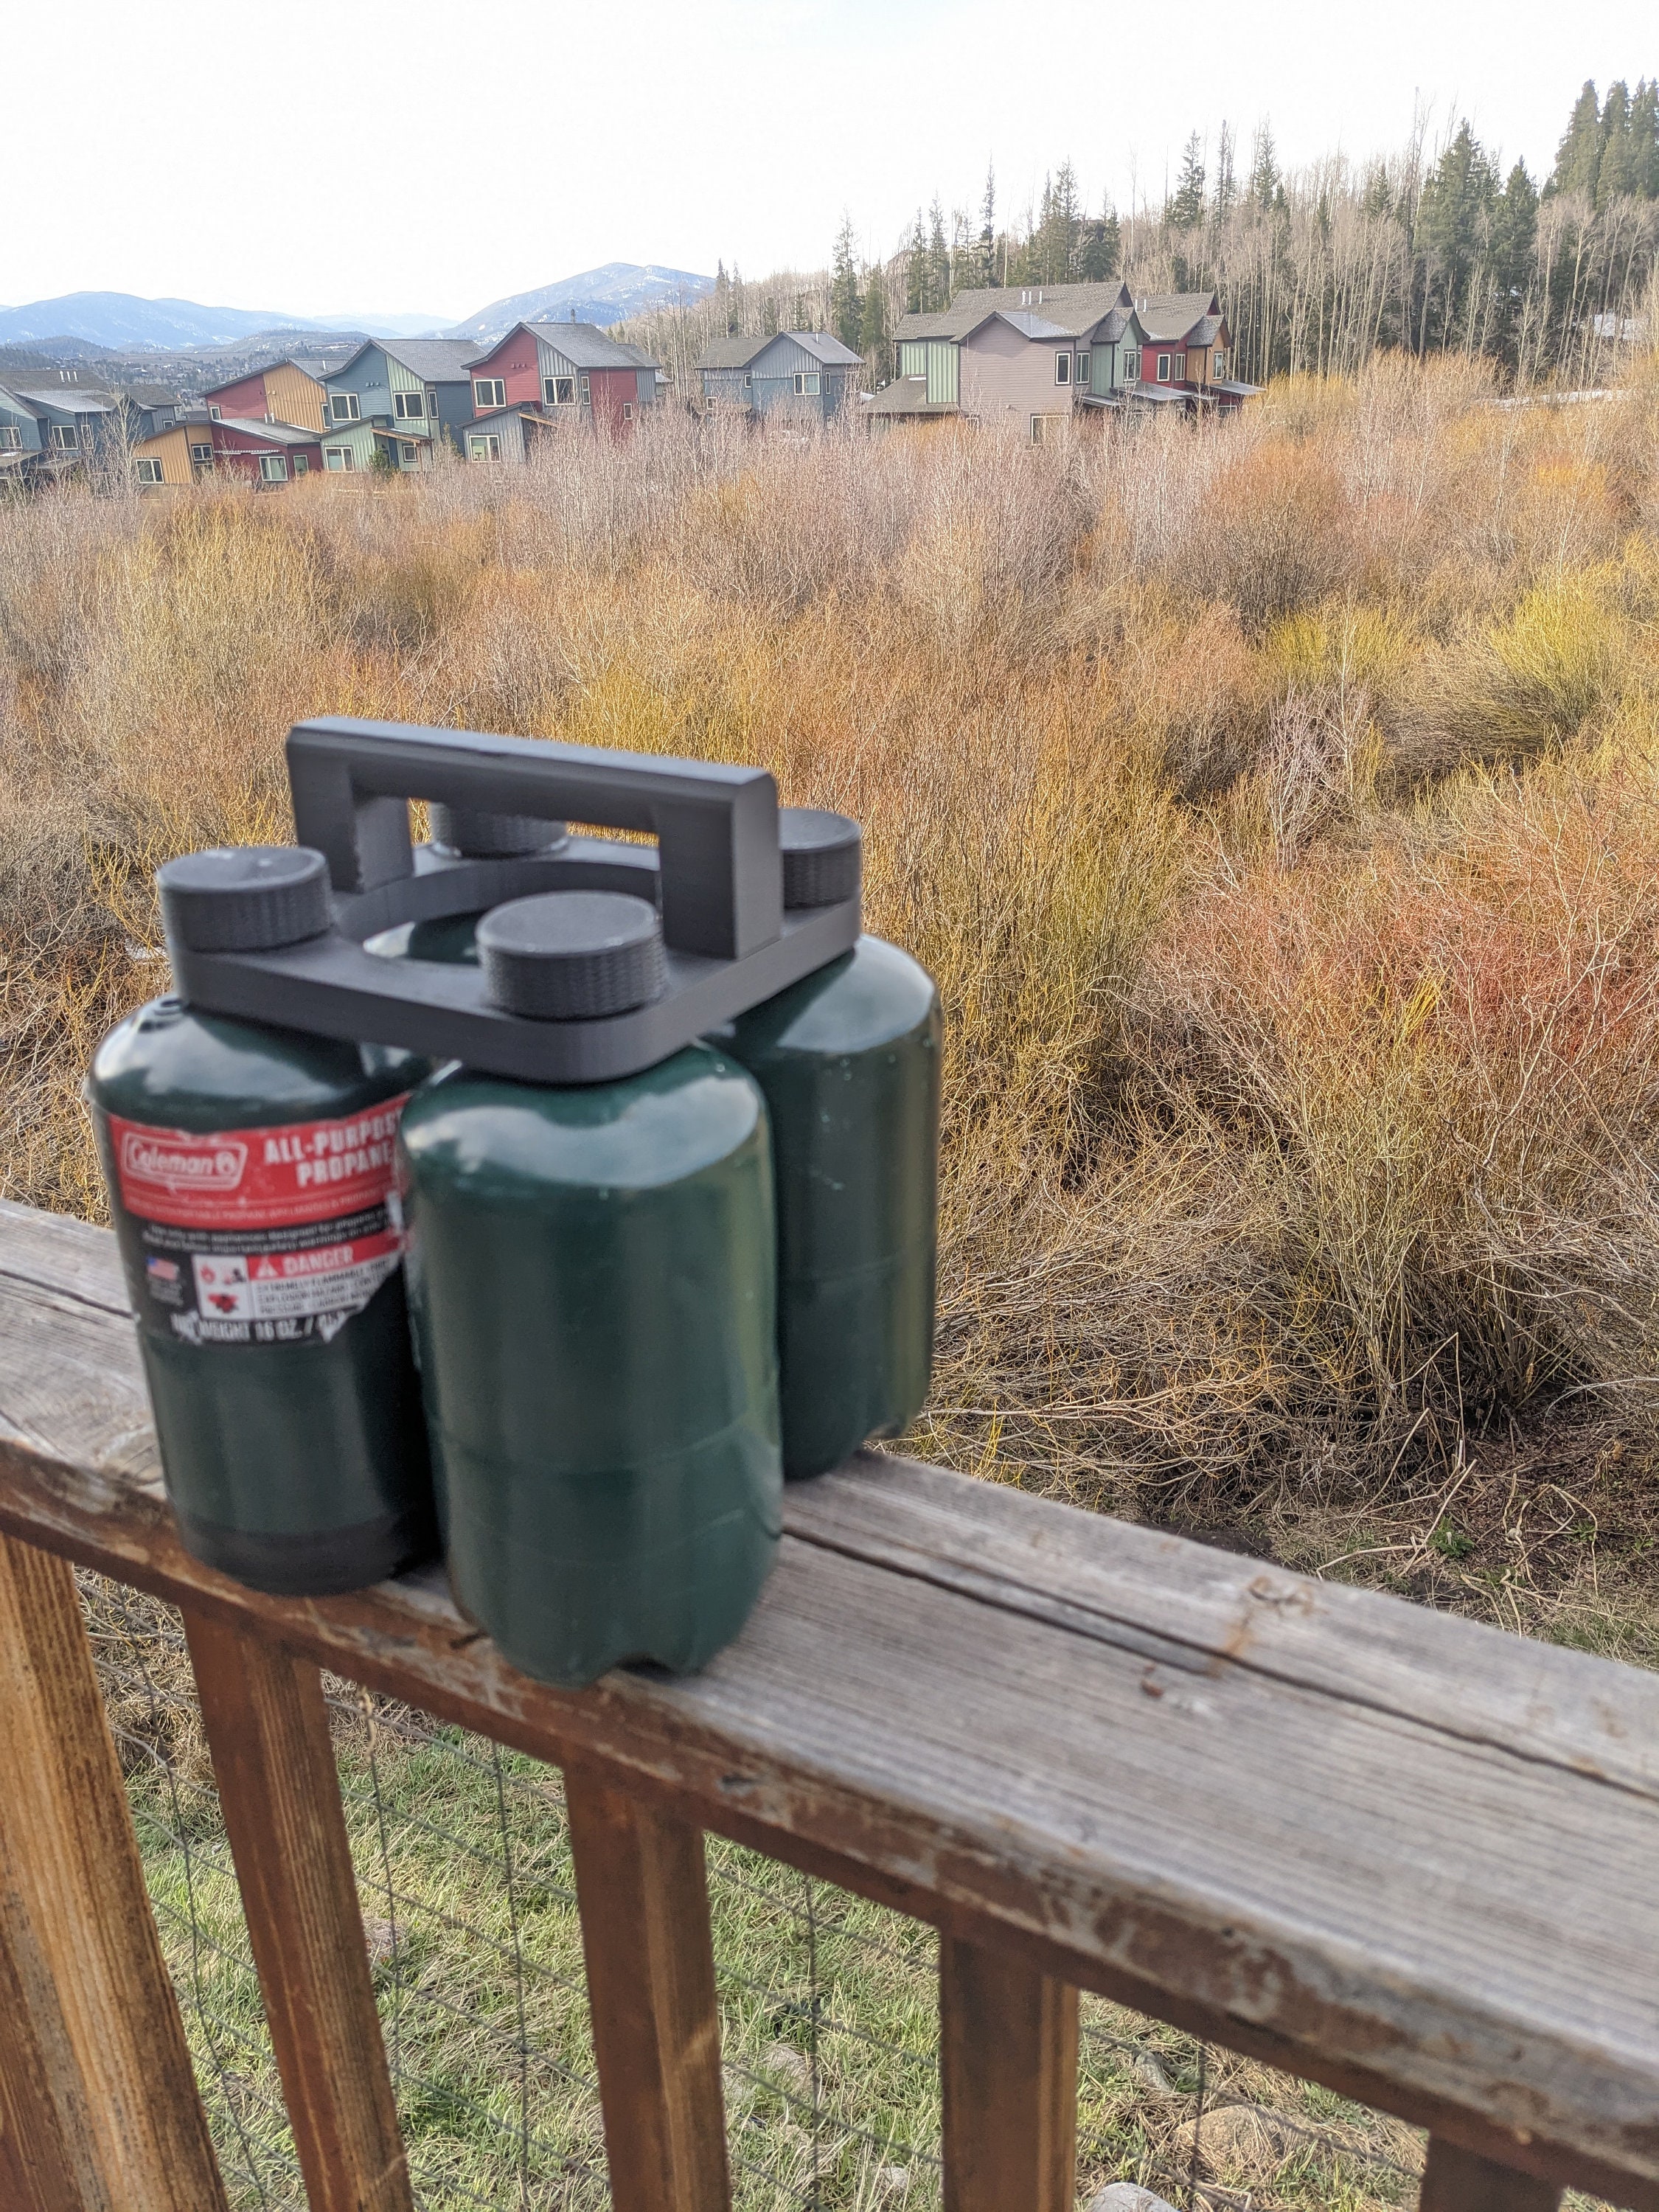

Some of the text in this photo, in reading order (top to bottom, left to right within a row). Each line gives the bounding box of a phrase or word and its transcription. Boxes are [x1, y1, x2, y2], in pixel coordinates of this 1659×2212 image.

[128, 1139, 213, 1177] Coleman
[284, 1248, 353, 1275] DANGER
[256, 1321, 275, 1341] 16
